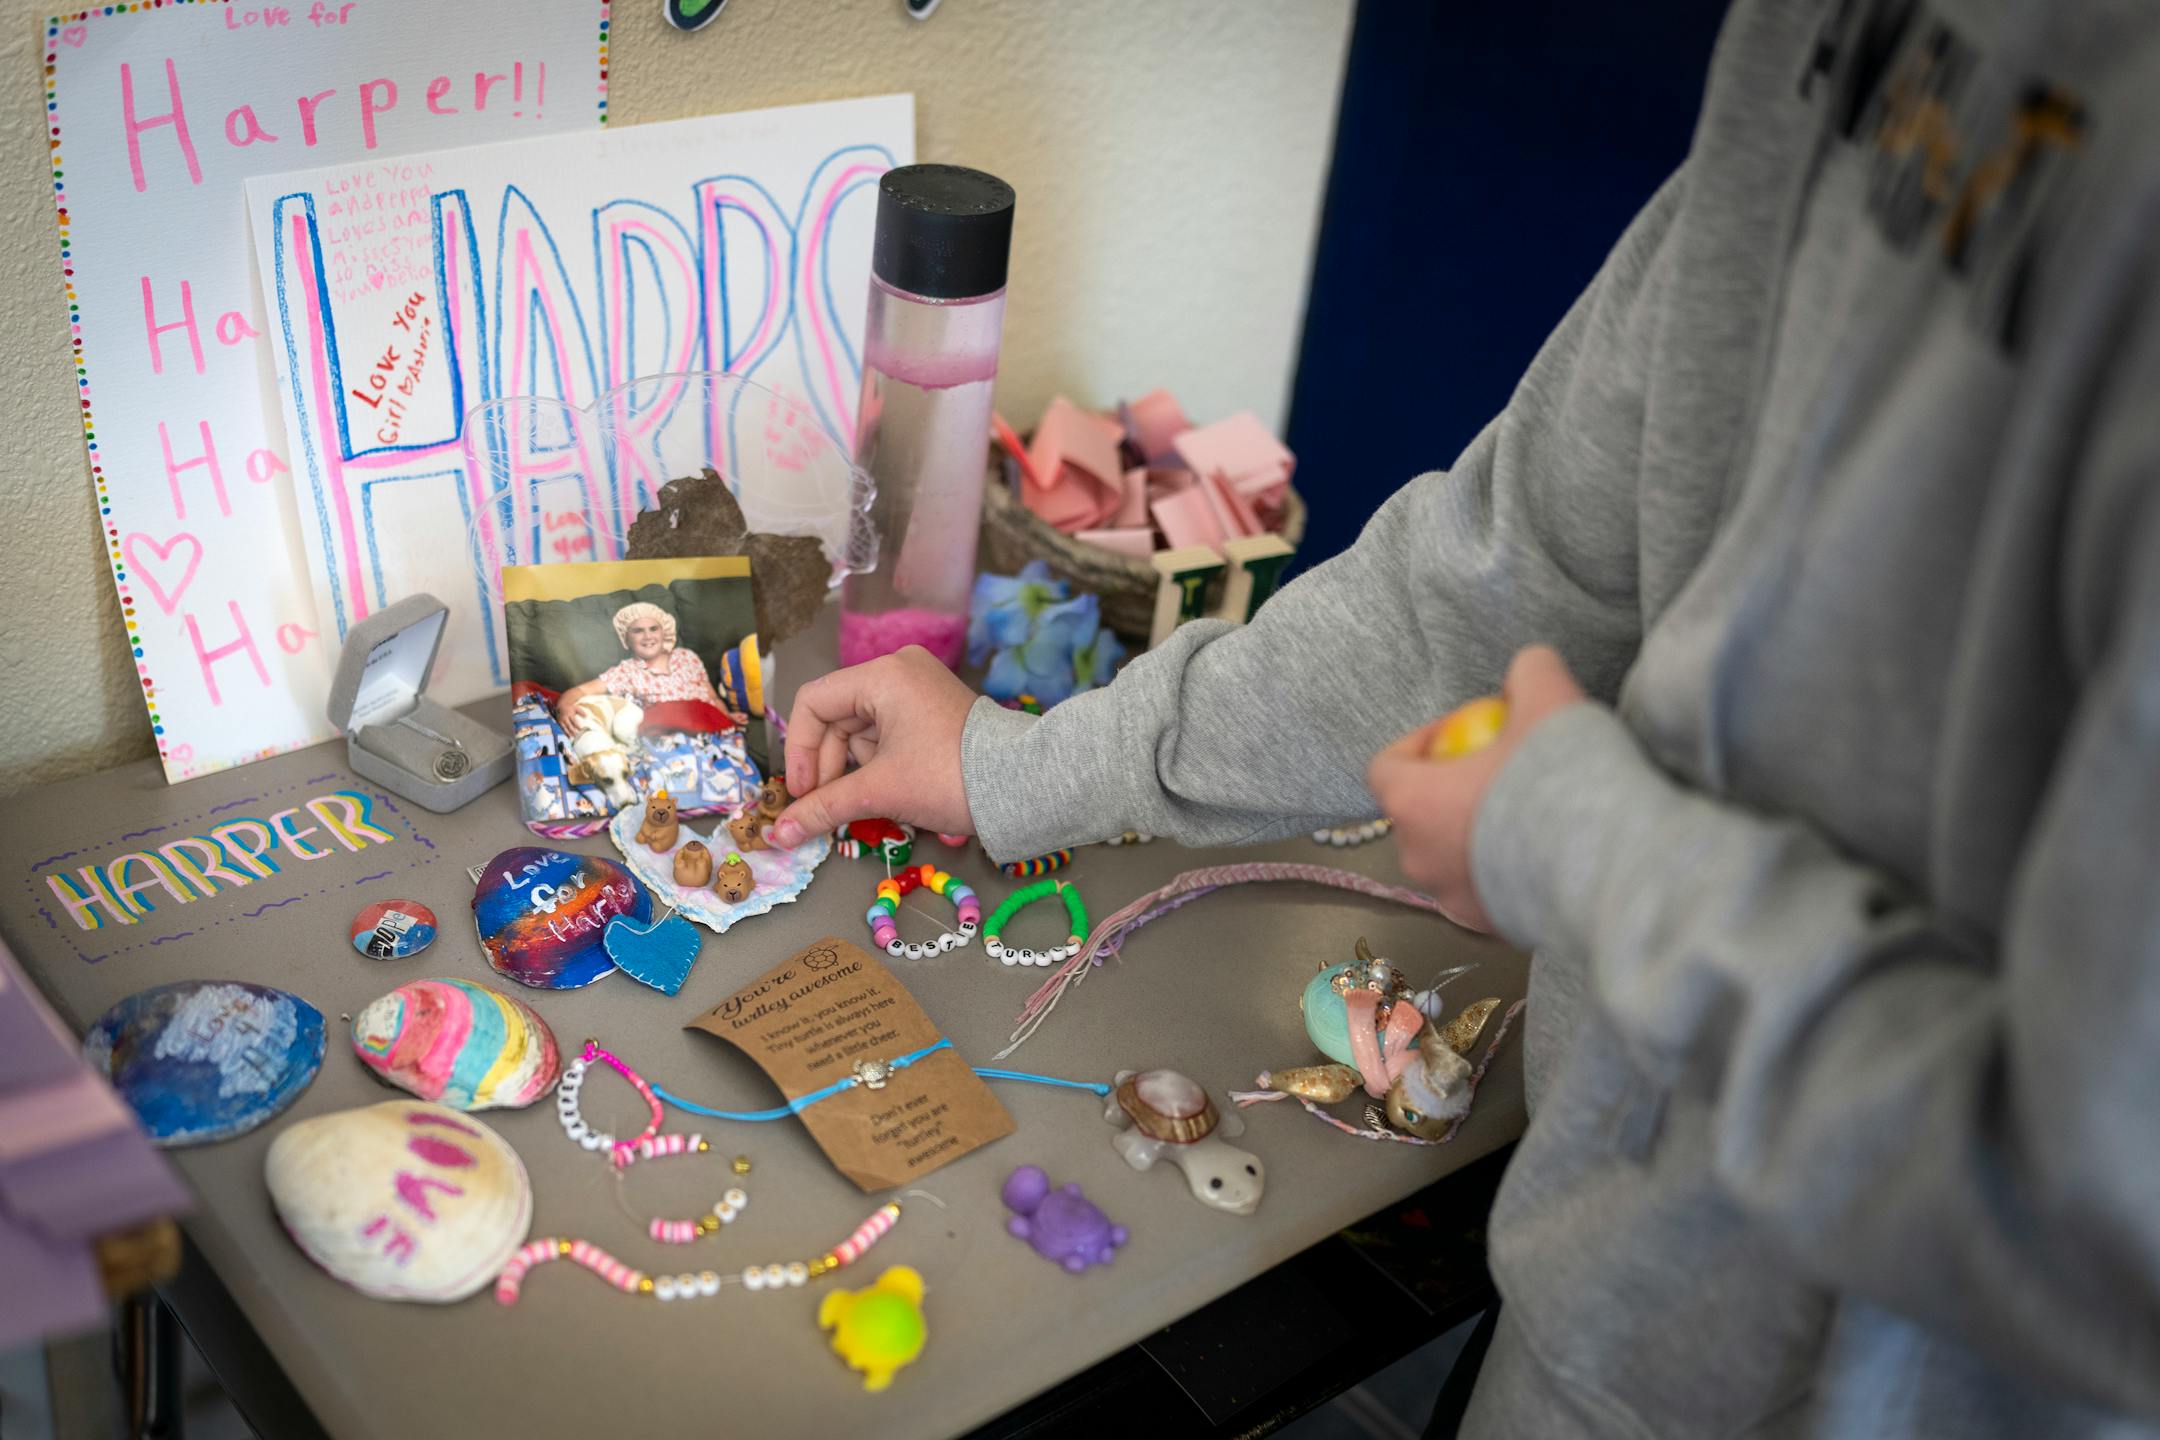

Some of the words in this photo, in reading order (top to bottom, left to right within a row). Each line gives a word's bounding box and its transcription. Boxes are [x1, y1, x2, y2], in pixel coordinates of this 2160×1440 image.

[225, 6, 291, 30] Love
[307, 2, 357, 28] for
[121, 58, 546, 192] Harper!!
[46, 790, 398, 930] HARPER
[503, 852, 571, 890] Love
[530, 870, 587, 915] for
[889, 922, 975, 954] BESTIE
[712, 968, 796, 1020] You're
[731, 997, 793, 1030] turtley
[789, 960, 863, 1001] awesome
[835, 1008, 872, 1027] always
[870, 997, 896, 1012] here
[766, 1022, 801, 1040] know
[813, 1006, 837, 1020] you
[835, 993, 868, 1009] know
[806, 1028, 859, 1054] whenever
[859, 1020, 881, 1035] you
[908, 1112, 931, 1129] you
[907, 1135, 959, 1168] awesome
